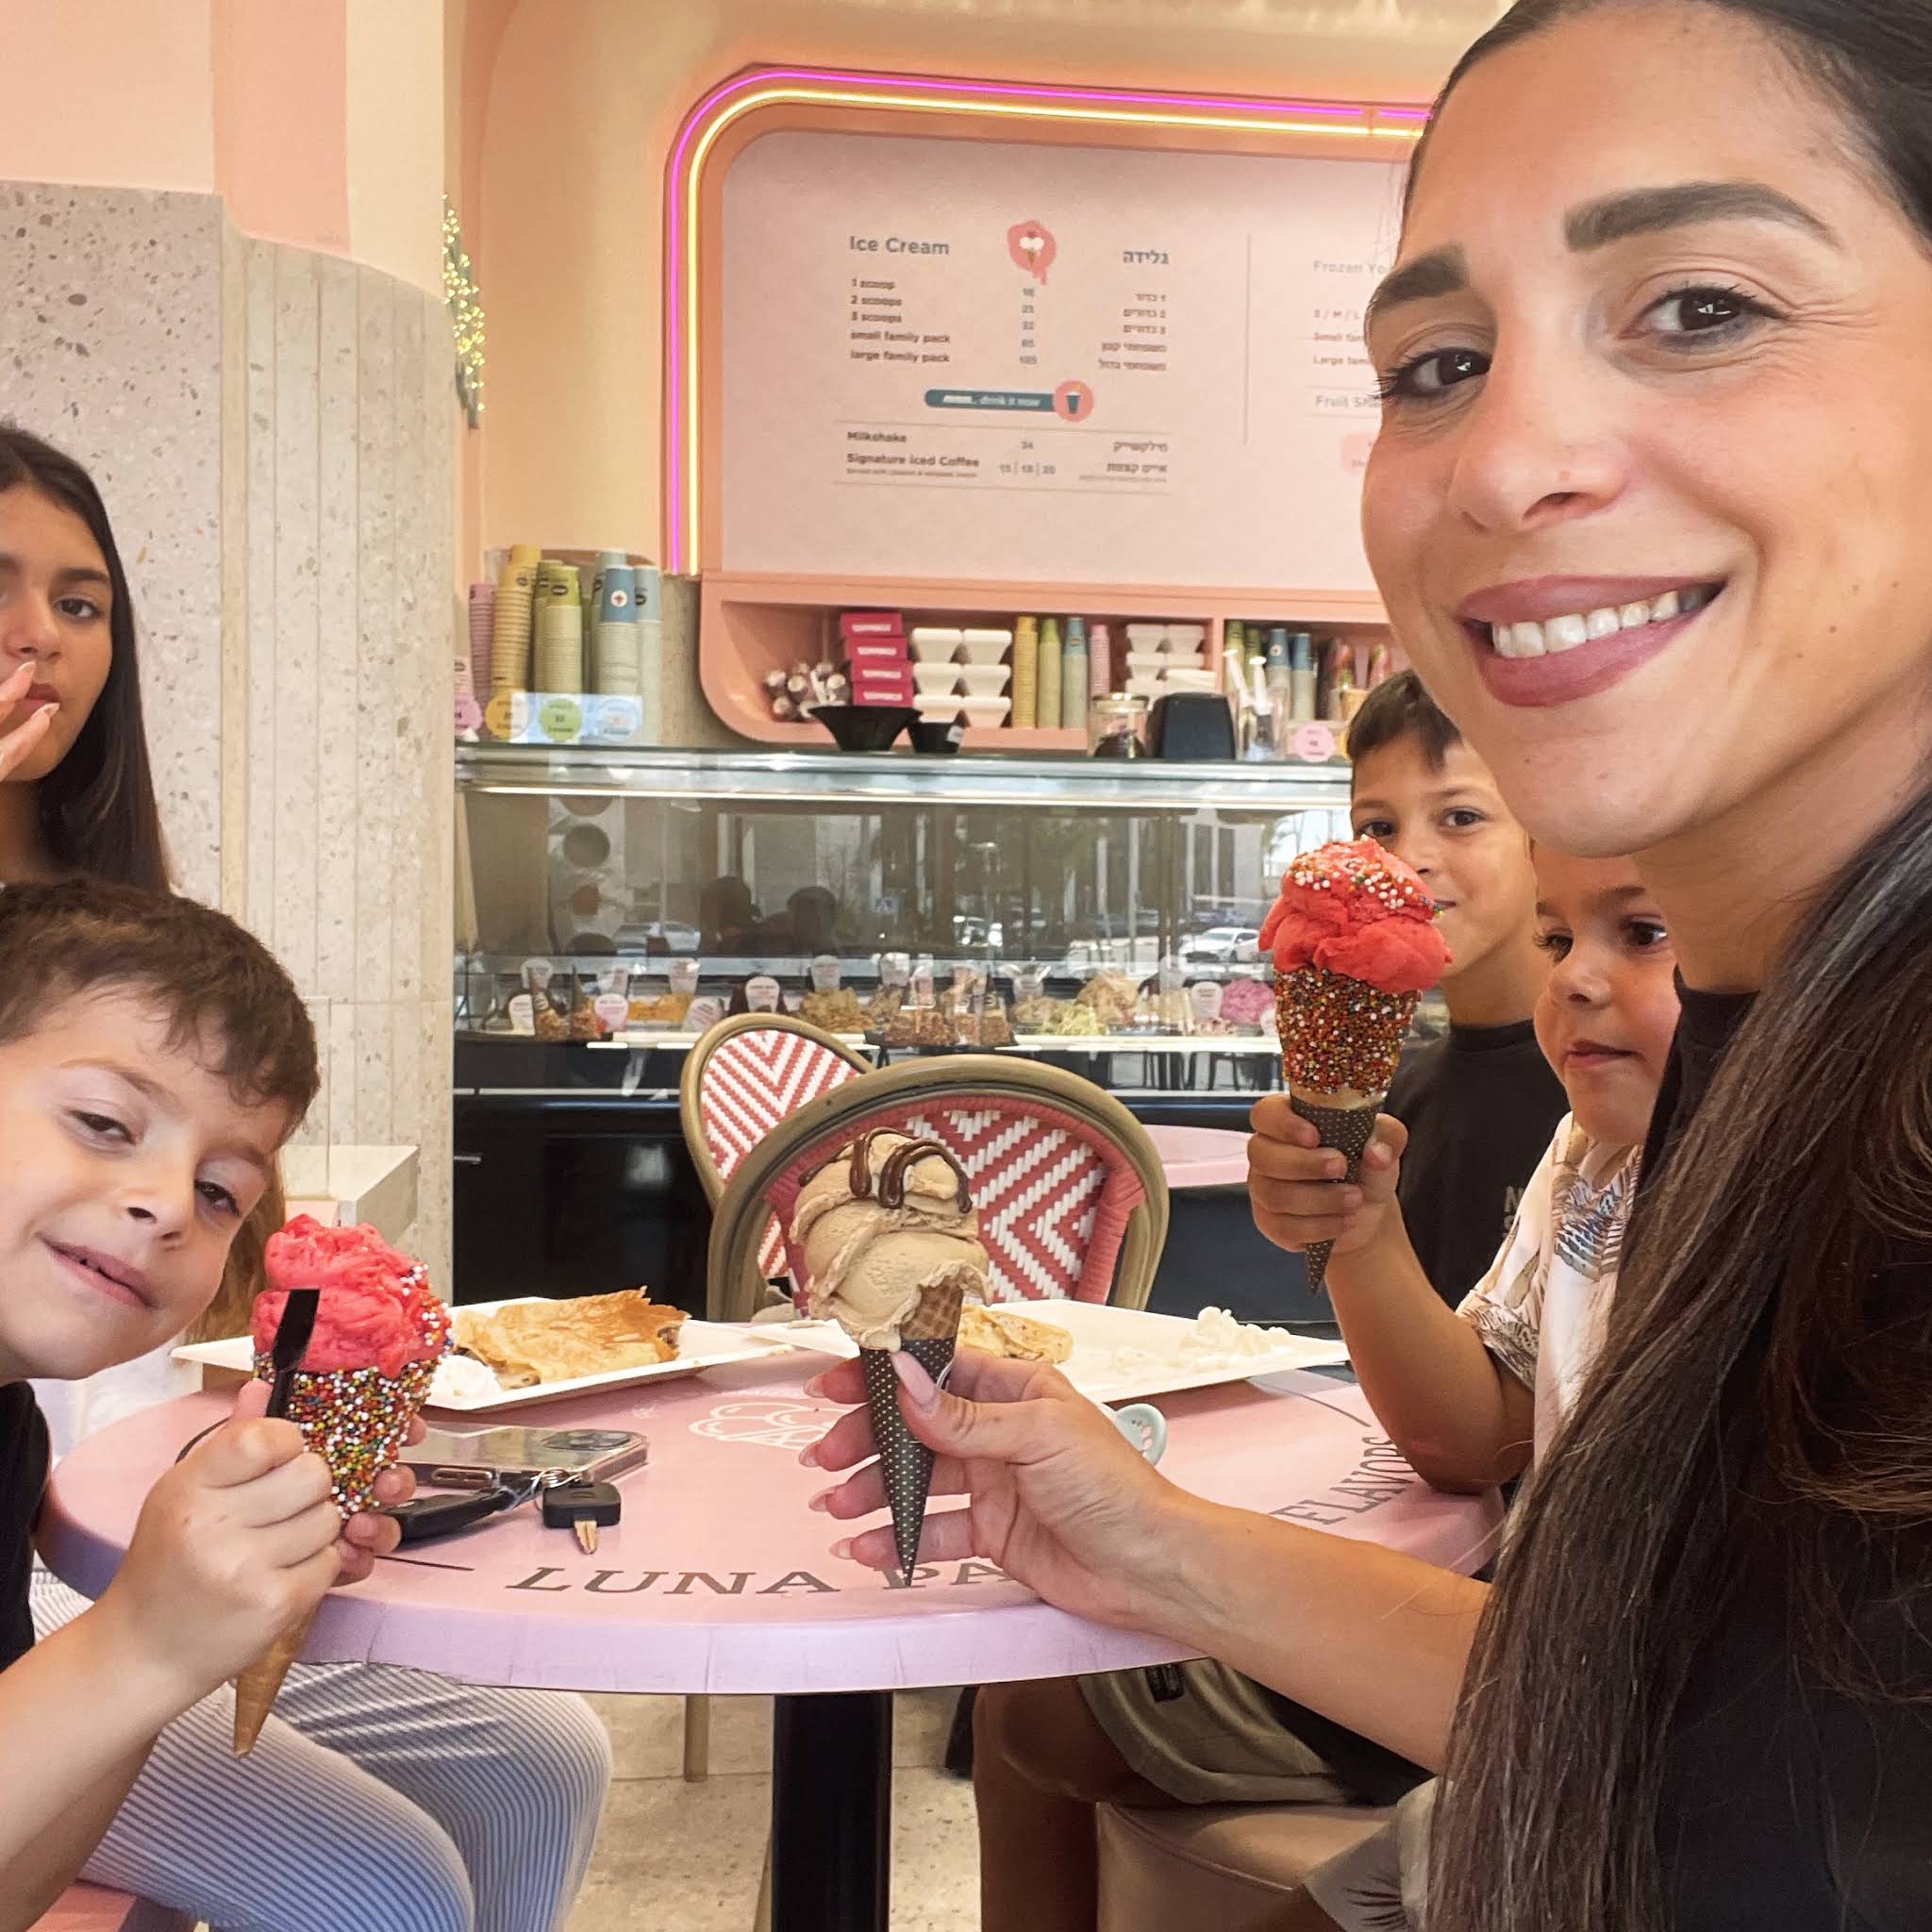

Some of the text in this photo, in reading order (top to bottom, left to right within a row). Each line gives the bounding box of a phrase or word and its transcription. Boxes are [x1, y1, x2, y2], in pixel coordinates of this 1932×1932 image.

[850, 235, 949, 255] Ice Cream
[1123, 250, 1169, 264] גלידה
[1313, 260, 1363, 274] Frozen
[851, 295, 858, 305] 2
[851, 331, 951, 343] small family pack
[883, 351, 919, 362] family
[922, 355, 950, 363] pack
[1316, 395, 1348, 408] Fruit
[847, 431, 908, 442] Milkshake
[847, 453, 906, 465] Signature
[939, 457, 979, 467] Coffee
[506, 1562, 1015, 1594] LUNA PA
